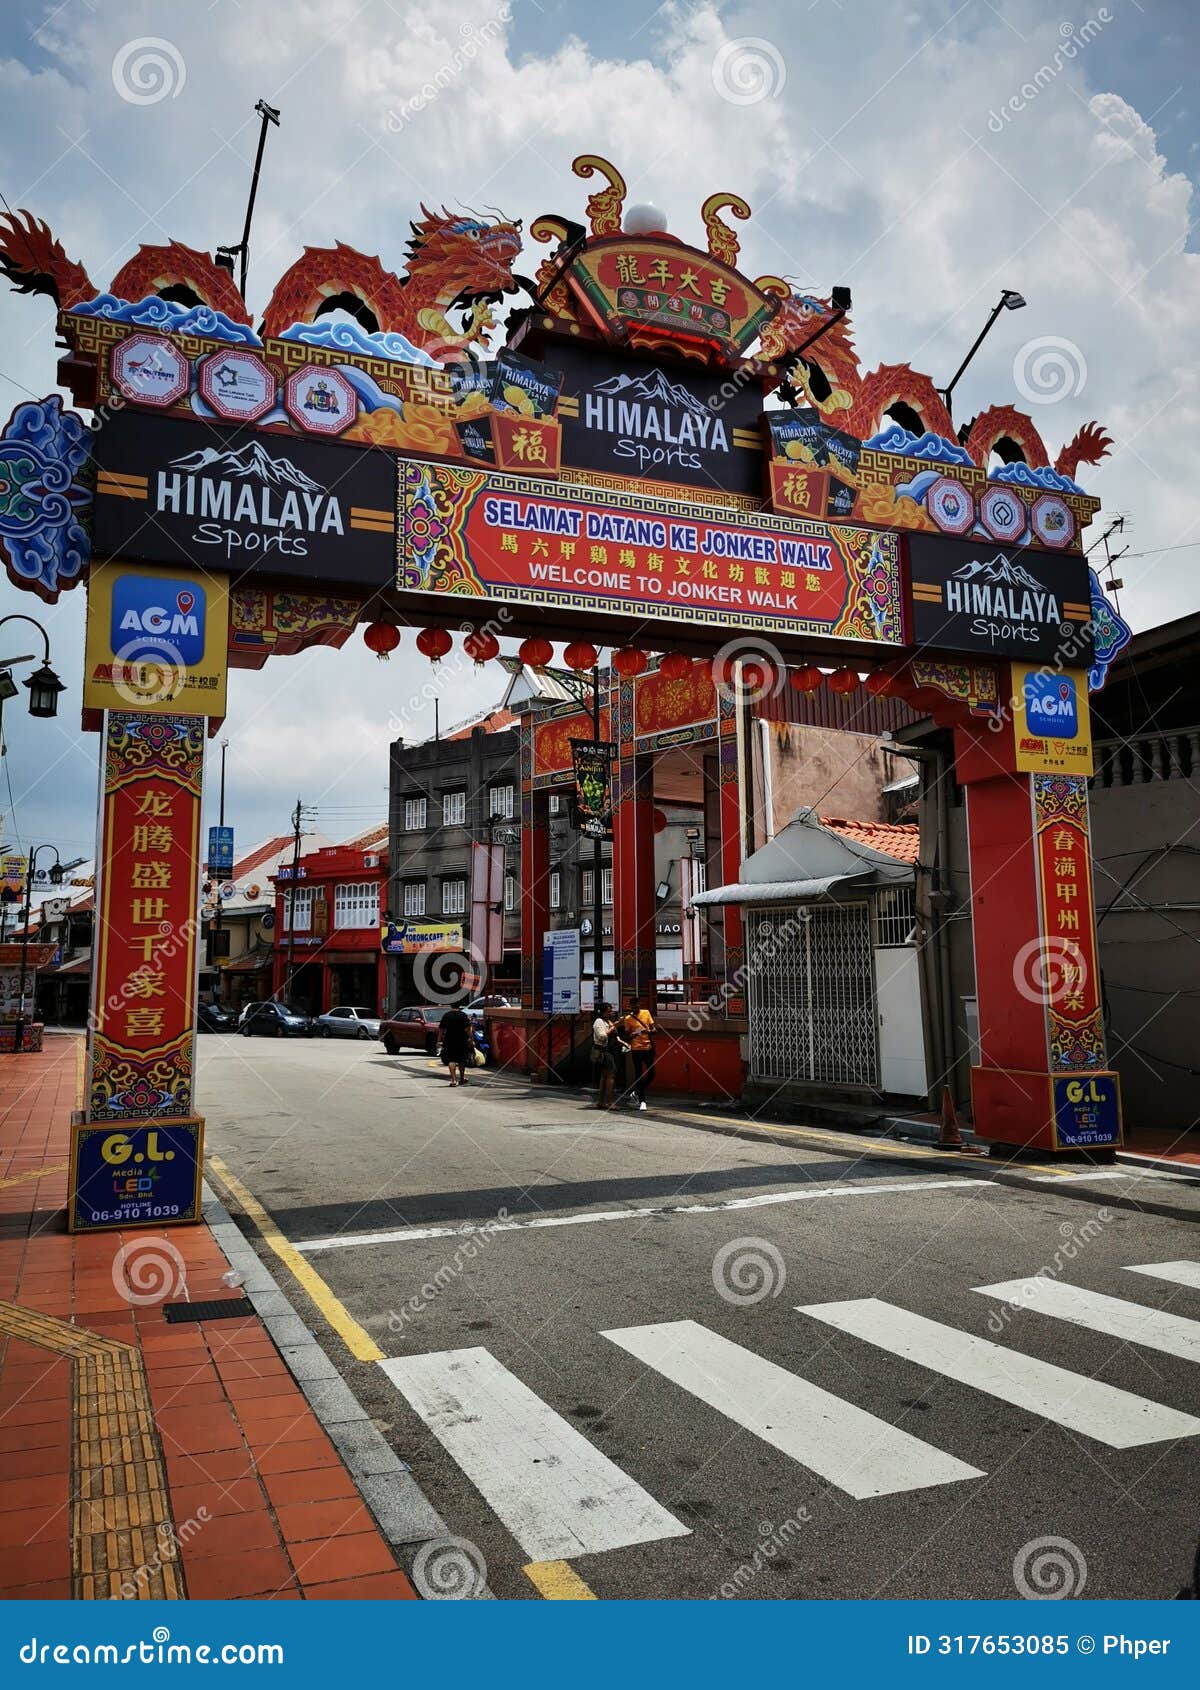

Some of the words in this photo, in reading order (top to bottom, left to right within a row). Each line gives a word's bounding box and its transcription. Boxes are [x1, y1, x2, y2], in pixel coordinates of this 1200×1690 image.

[615, 254, 731, 306] 龍年大吉
[505, 370, 549, 396] HIMALAYA
[585, 393, 729, 453] HIMALAYA
[780, 427, 816, 439] HIMALAYA
[511, 427, 547, 463] 福
[613, 438, 702, 469] Sports
[156, 470, 345, 536] HIMALAYA
[783, 472, 811, 509] 福
[191, 522, 308, 558] Sports
[485, 497, 583, 537] SELAMAT
[586, 511, 666, 549] DATANG
[670, 524, 698, 553] KE
[701, 529, 777, 564] JONKER
[779, 539, 832, 571] WALK
[528, 562, 631, 591] WELCOME
[636, 575, 662, 594] TO
[667, 581, 743, 604] JONKER
[747, 589, 799, 610] WALK
[946, 580, 1061, 625] HIMALAYA
[120, 606, 199, 636] AGM
[969, 618, 1040, 647] Sports
[1030, 695, 1074, 717] AGM
[124, 790, 174, 1037] 龙腾盛世千家喜
[656, 924, 680, 933] IAO
[1052, 830, 1085, 1011] 春满甲州万物荣
[1066, 1081, 1107, 1103] G.L.
[101, 1132, 175, 1165] G.L.
[113, 1177, 153, 1193] LED
[91, 1208, 140, 1221] 06-910
[145, 1204, 179, 1217] 1039
[121, 1201, 152, 1209] HOTLINE
